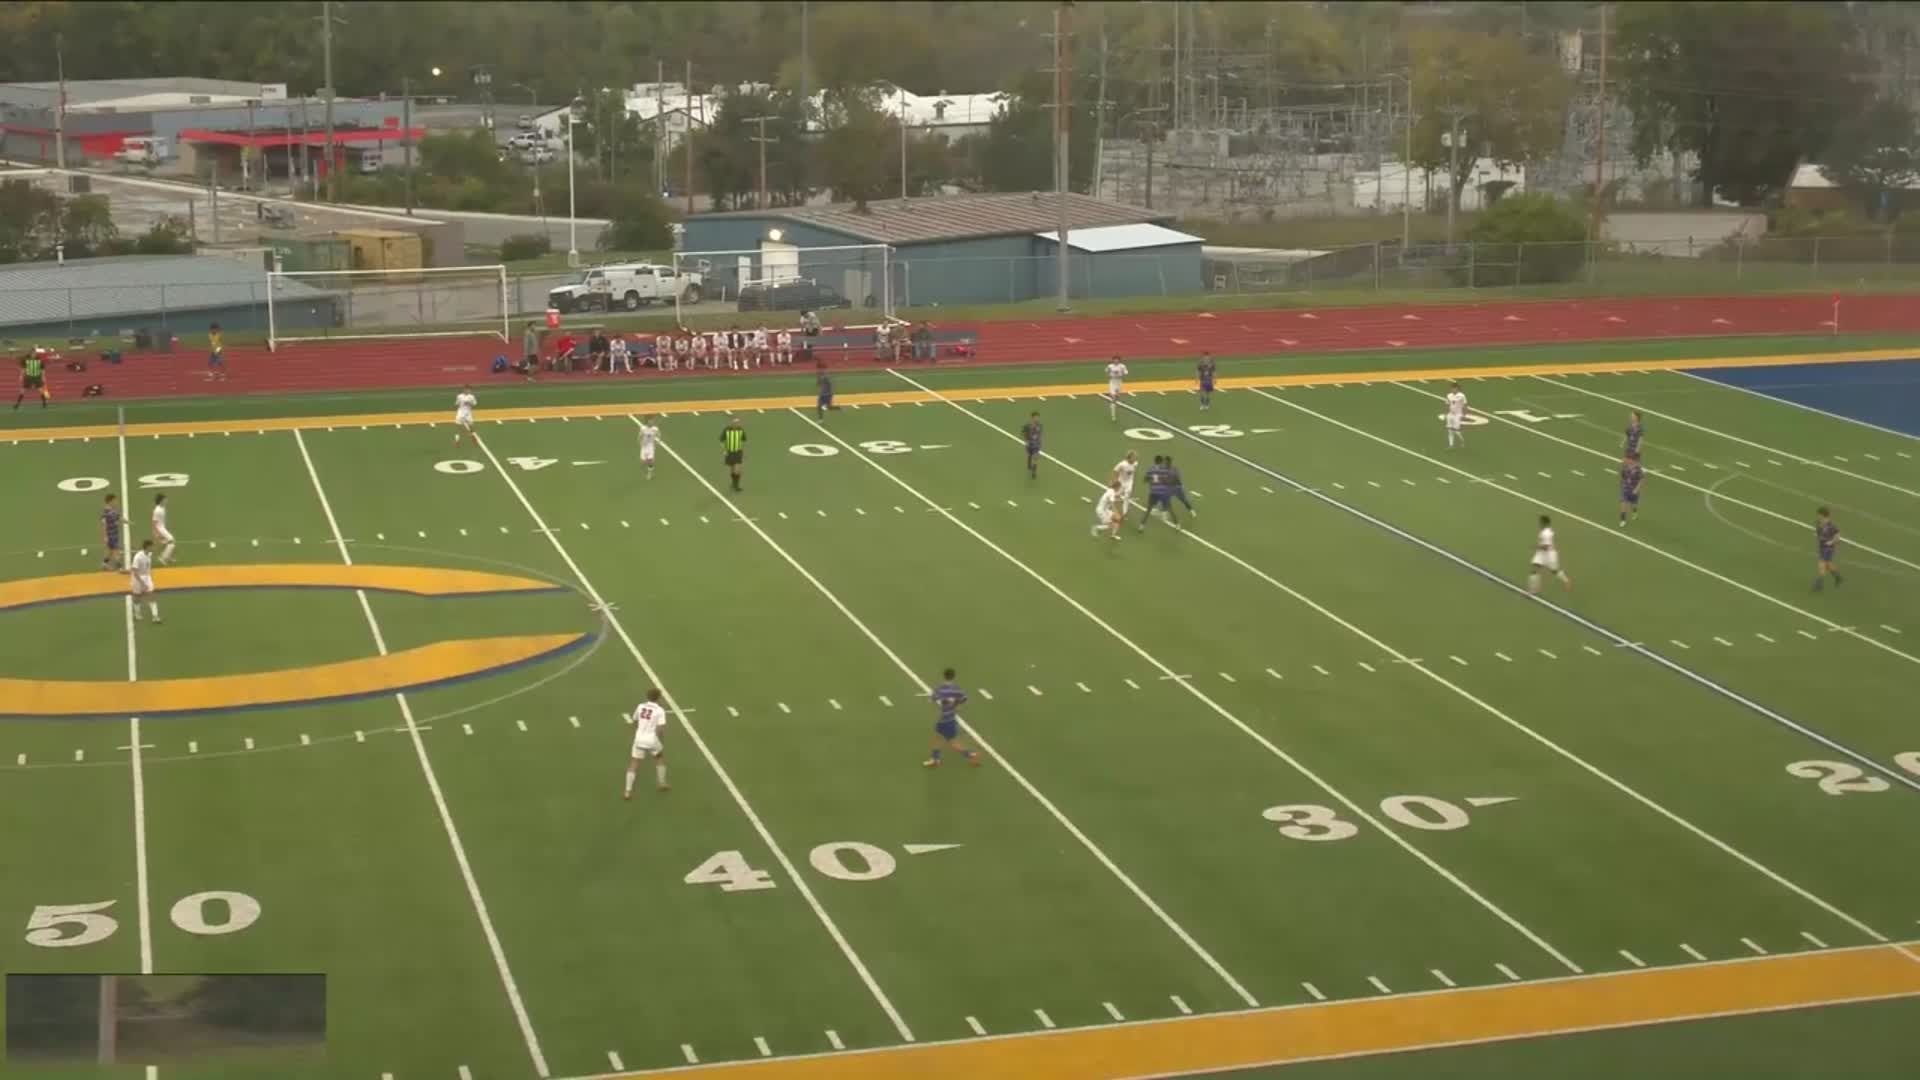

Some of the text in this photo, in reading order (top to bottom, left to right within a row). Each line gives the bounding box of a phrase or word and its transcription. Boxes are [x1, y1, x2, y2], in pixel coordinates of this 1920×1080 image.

[640, 707, 653, 720] 22
[1262, 795, 1471, 842] 30
[684, 841, 897, 892] 40
[25, 891, 262, 948] 50
